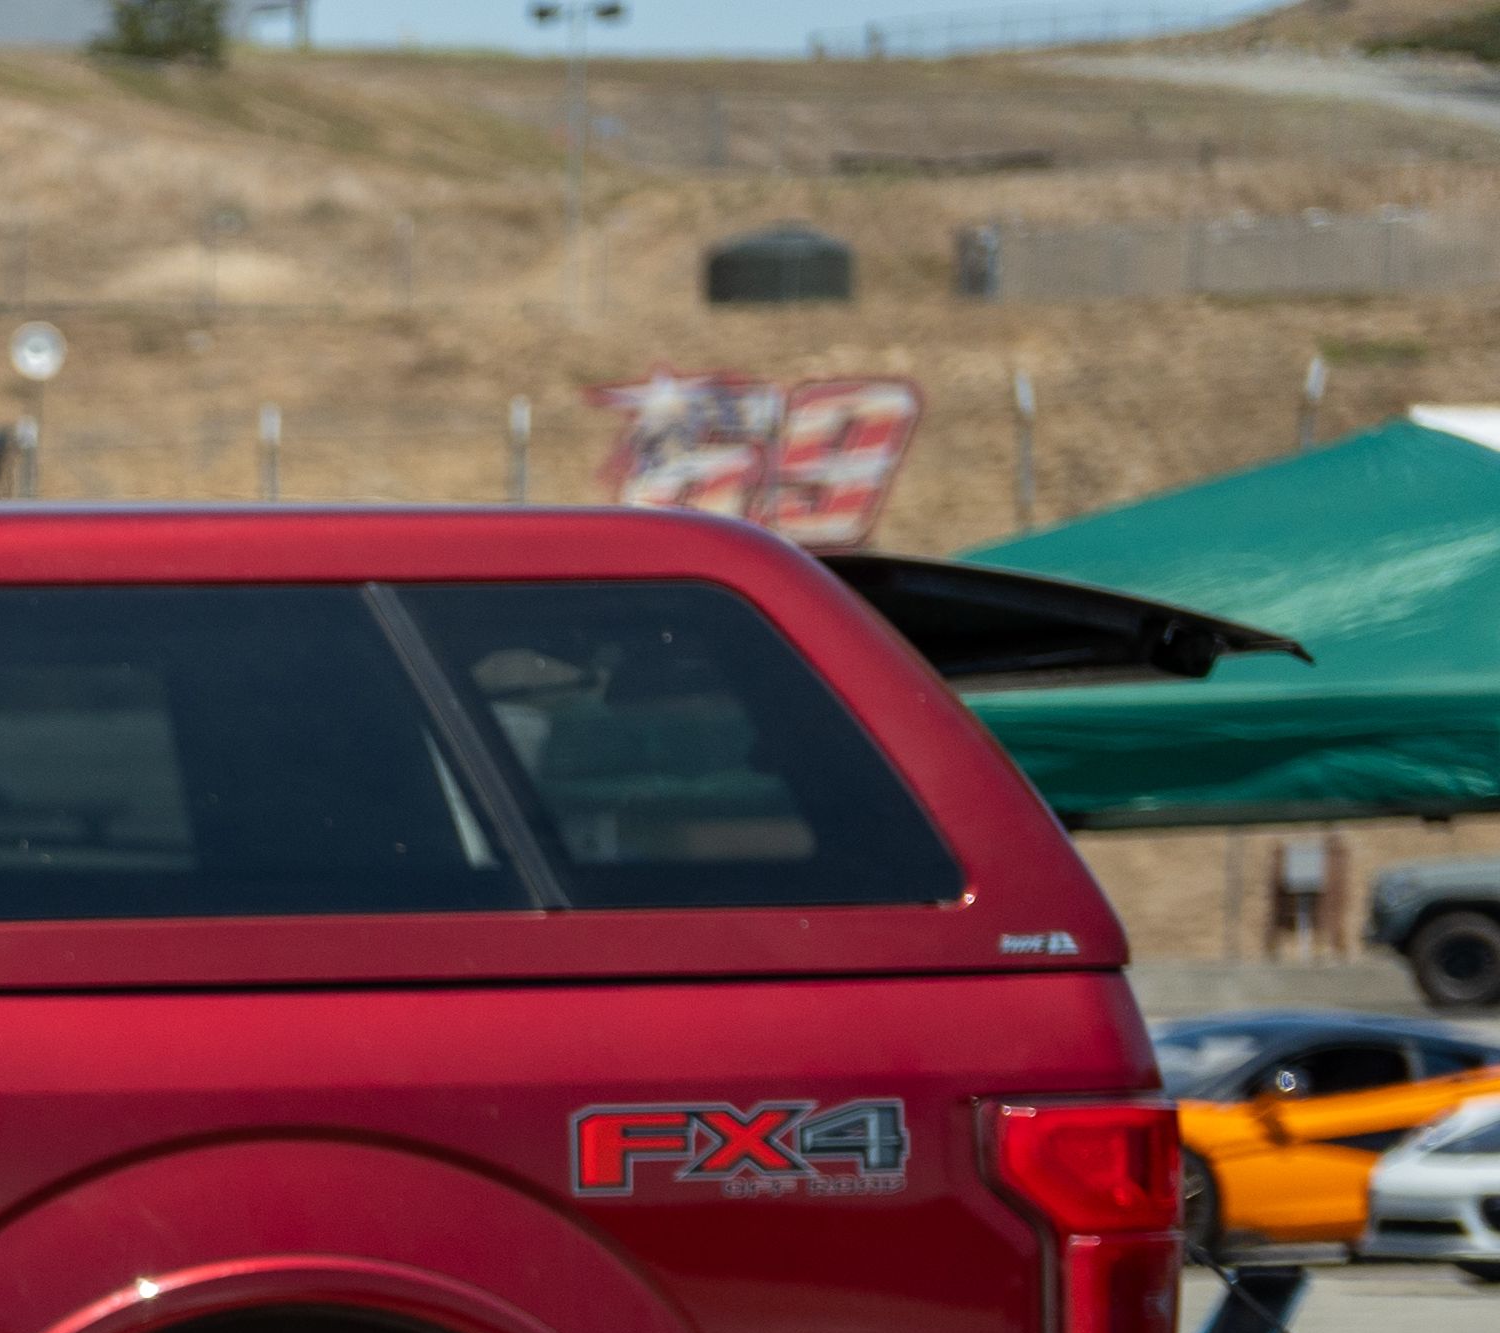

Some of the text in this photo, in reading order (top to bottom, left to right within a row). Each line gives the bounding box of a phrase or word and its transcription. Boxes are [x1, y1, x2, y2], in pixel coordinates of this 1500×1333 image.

[572, 1098, 910, 1196] FX4
[722, 1174, 906, 1198] OFF ROAD
